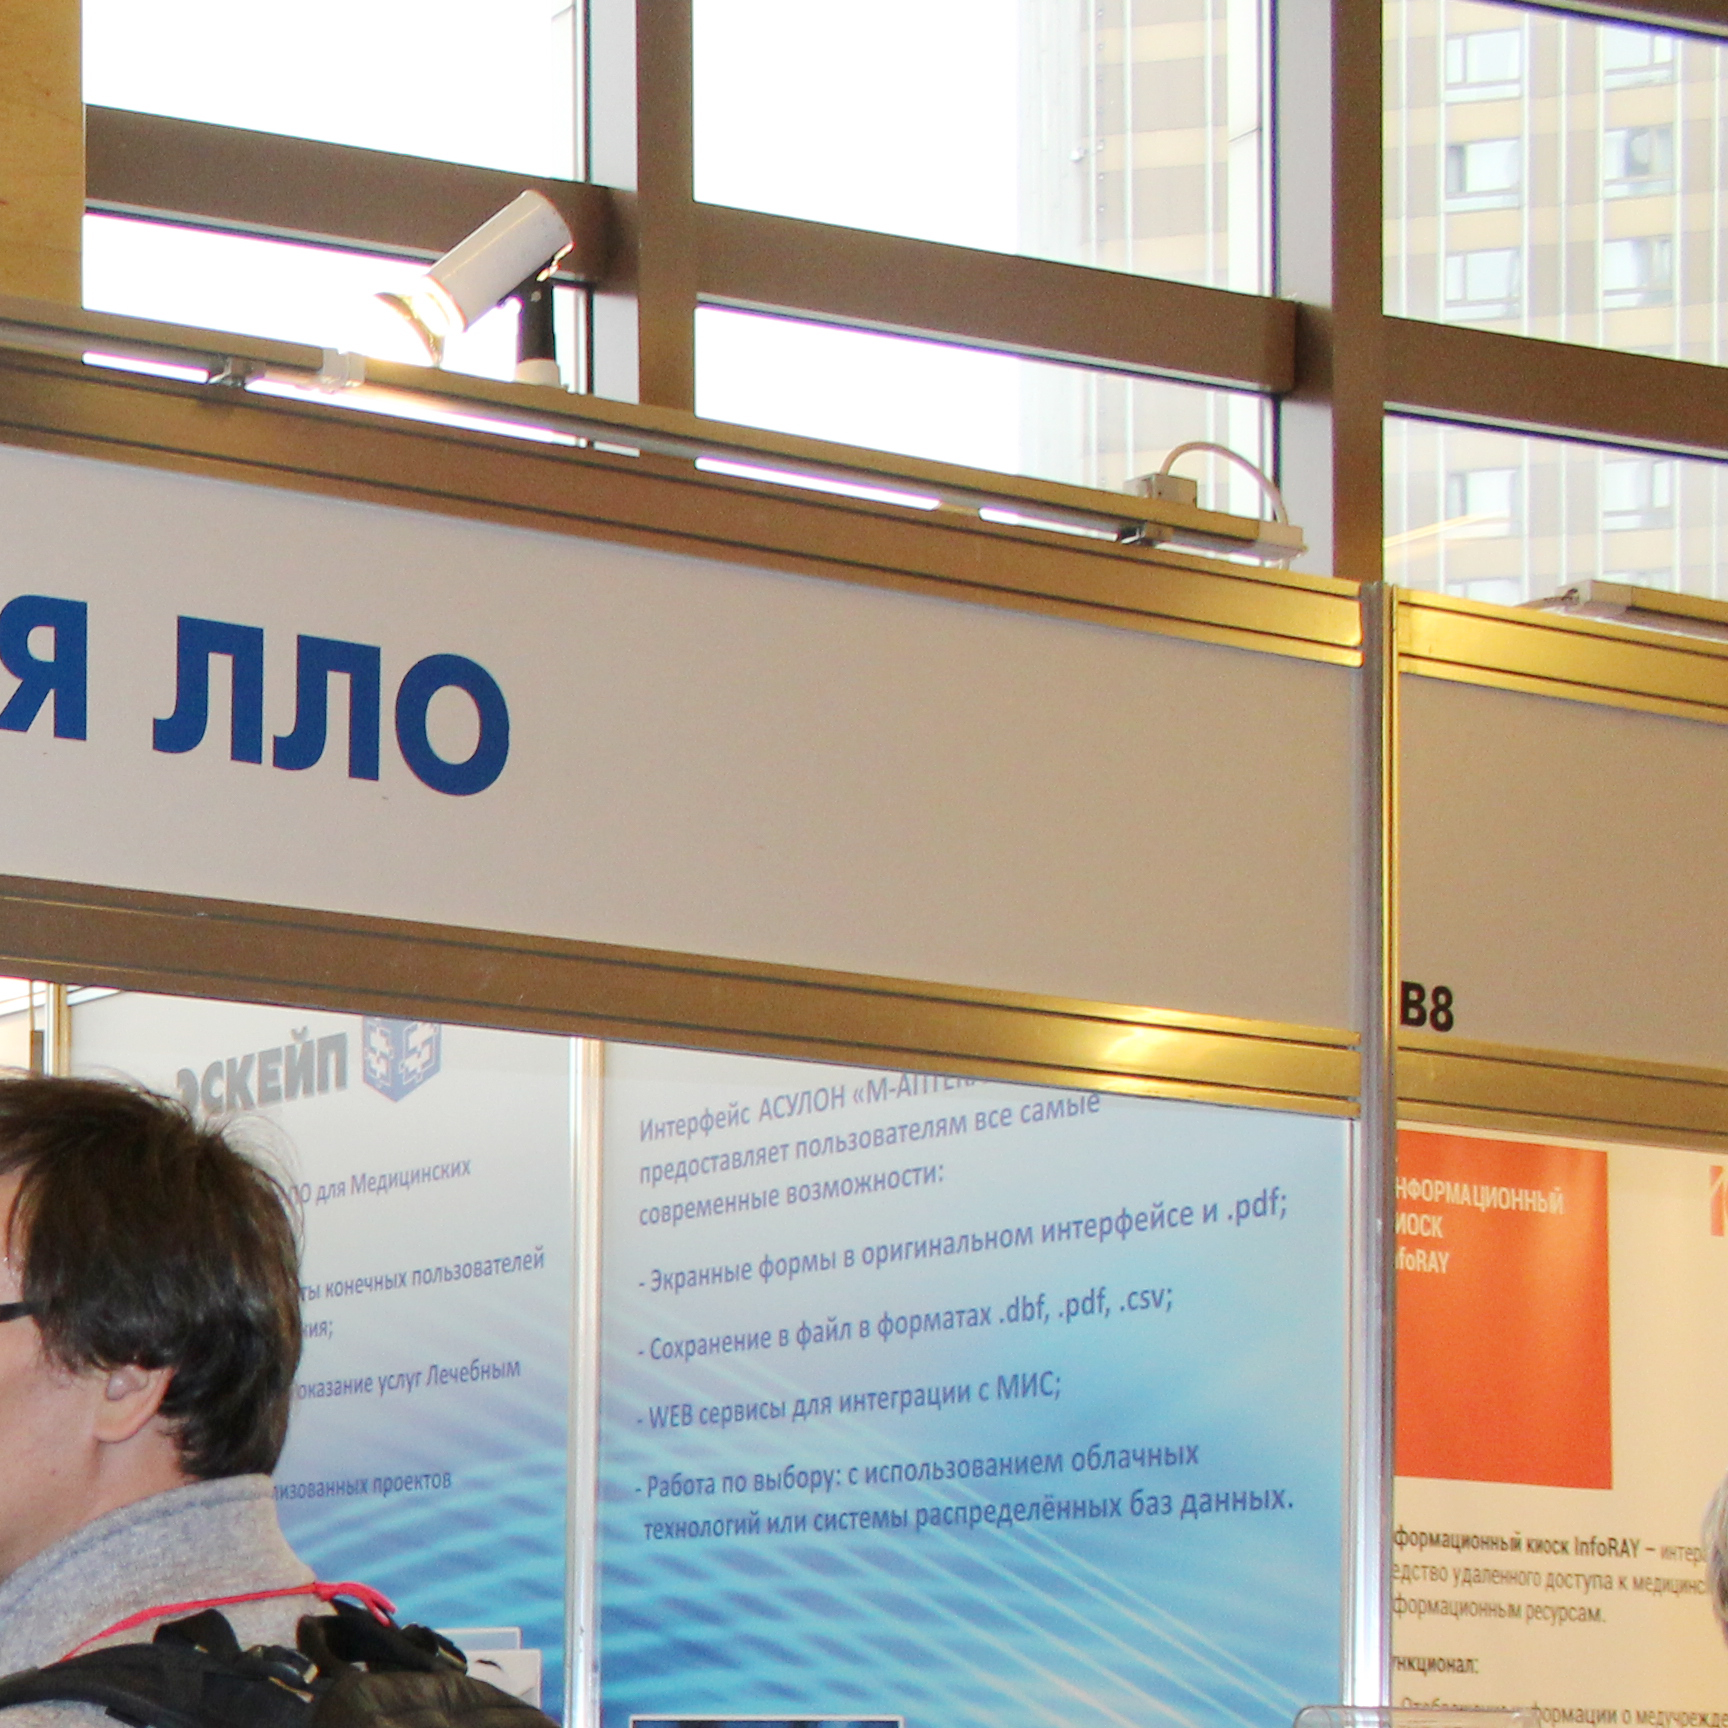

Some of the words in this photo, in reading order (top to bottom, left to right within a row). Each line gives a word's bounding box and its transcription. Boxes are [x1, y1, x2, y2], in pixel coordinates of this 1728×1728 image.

[151, 616, 511, 797] ЛЛО
[640, 1101, 751, 1142] Интерфейс
[759, 1084, 845, 1122] АСУЛОН
[640, 1143, 789, 1188] предоставляет
[796, 1114, 967, 1160] пользователям
[975, 1107, 1012, 1131] все
[1020, 1093, 1100, 1124] самые
[317, 1181, 345, 1205] для
[350, 1159, 471, 1195] Медицинских
[640, 1188, 779, 1226] современные
[787, 1164, 944, 1204] возможности:
[650, 1262, 752, 1294] Экранные
[759, 1254, 836, 1284] формы
[844, 1249, 854, 1268] в
[862, 1223, 1033, 1270] оригинальном
[1041, 1202, 1194, 1243] интерфейсе
[1203, 1202, 1218, 1224] и
[1227, 1187, 1287, 1226] .pdf;
[326, 1270, 407, 1298] конечных
[412, 1245, 545, 1287] пользователей
[650, 1330, 772, 1362] Сохранение
[779, 1329, 789, 1347] в
[796, 1315, 851, 1350] файл
[859, 1319, 870, 1338] в
[877, 1304, 992, 1343] форматах
[999, 1294, 1050, 1324] .dbf,
[1058, 1286, 1111, 1324] .pdf,
[1120, 1286, 1173, 1314] .csv;
[298, 1376, 373, 1400] оказание
[378, 1369, 423, 1397] услуг
[426, 1358, 521, 1387] Лечебным
[649, 1404, 693, 1429] WEB
[699, 1401, 786, 1429] сервисы
[792, 1396, 832, 1422] для
[840, 1384, 971, 1416] интеграции
[978, 1380, 989, 1401] с
[997, 1370, 1061, 1400] МИС;
[373, 1471, 452, 1497] проектов
[647, 1472, 715, 1497] Работа
[722, 1474, 746, 1494] по
[754, 1464, 841, 1493] выбору:
[848, 1466, 858, 1485] с
[865, 1451, 1063, 1484] использованием
[1071, 1443, 1200, 1473] облачных
[644, 1510, 760, 1540] технологий
[767, 1515, 806, 1533] или
[813, 1508, 907, 1532] системы
[915, 1494, 1122, 1531] распределённых
[1129, 1489, 1172, 1517] баз
[1179, 1488, 1294, 1520] данных.
